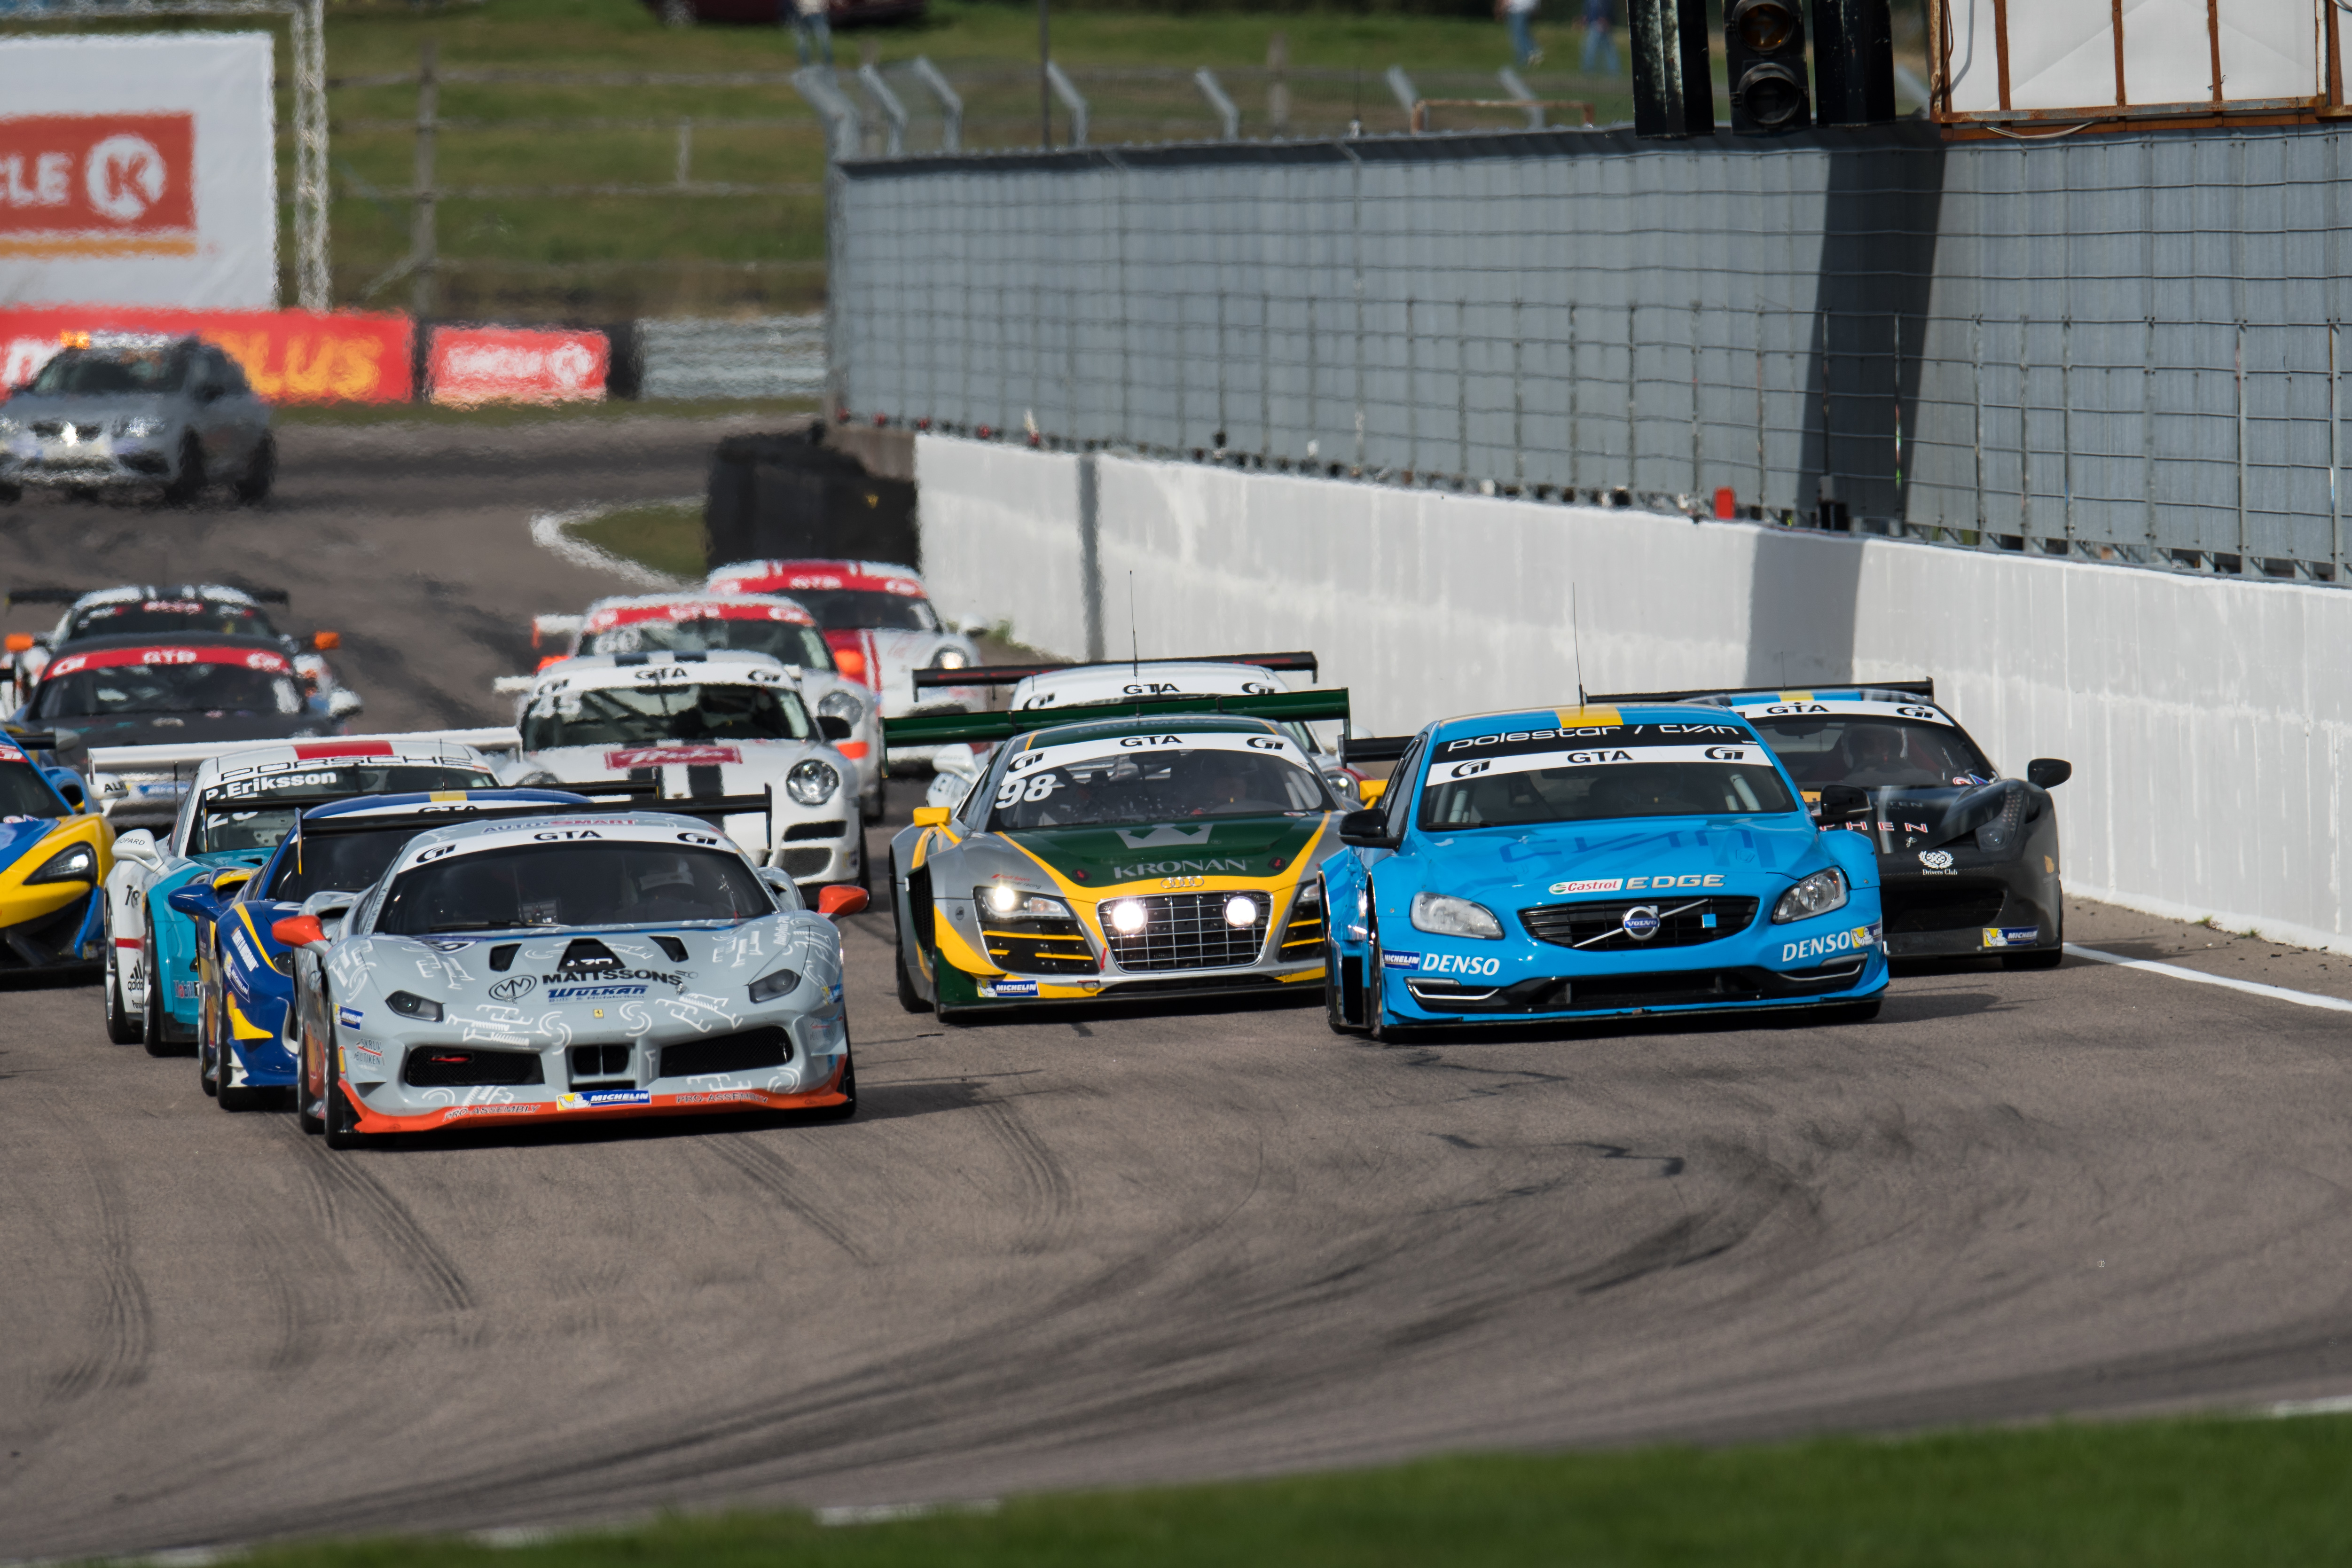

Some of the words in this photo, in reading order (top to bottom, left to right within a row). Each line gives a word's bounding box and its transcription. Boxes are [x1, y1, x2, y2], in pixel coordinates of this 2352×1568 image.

[0, 150, 72, 208] LE
[200, 329, 383, 400] LUS
[635, 667, 688, 680] GTA
[1122, 682, 1181, 694] GTA
[1766, 704, 1830, 714] GTA
[1120, 735, 1184, 747] GTA
[1447, 726, 1621, 752] polestar
[1568, 750, 1634, 763] GTA
[221, 755, 473, 782] PORSCHE
[995, 773, 1057, 809] 98
[480, 819, 635, 834] AUTOMART
[533, 830, 603, 841] GTA
[1114, 859, 1247, 879] KRONAN
[1568, 880, 1617, 891] Castrol
[1625, 874, 1728, 890] EDGE
[1782, 931, 1850, 963] DENSO
[1384, 955, 1419, 965] MICHELIN
[1422, 953, 1500, 976] DENSO
[542, 969, 683, 985] MATTSSONS
[361, 1038, 382, 1051] SKRUV
[590, 1092, 649, 1102] MICHELIN
